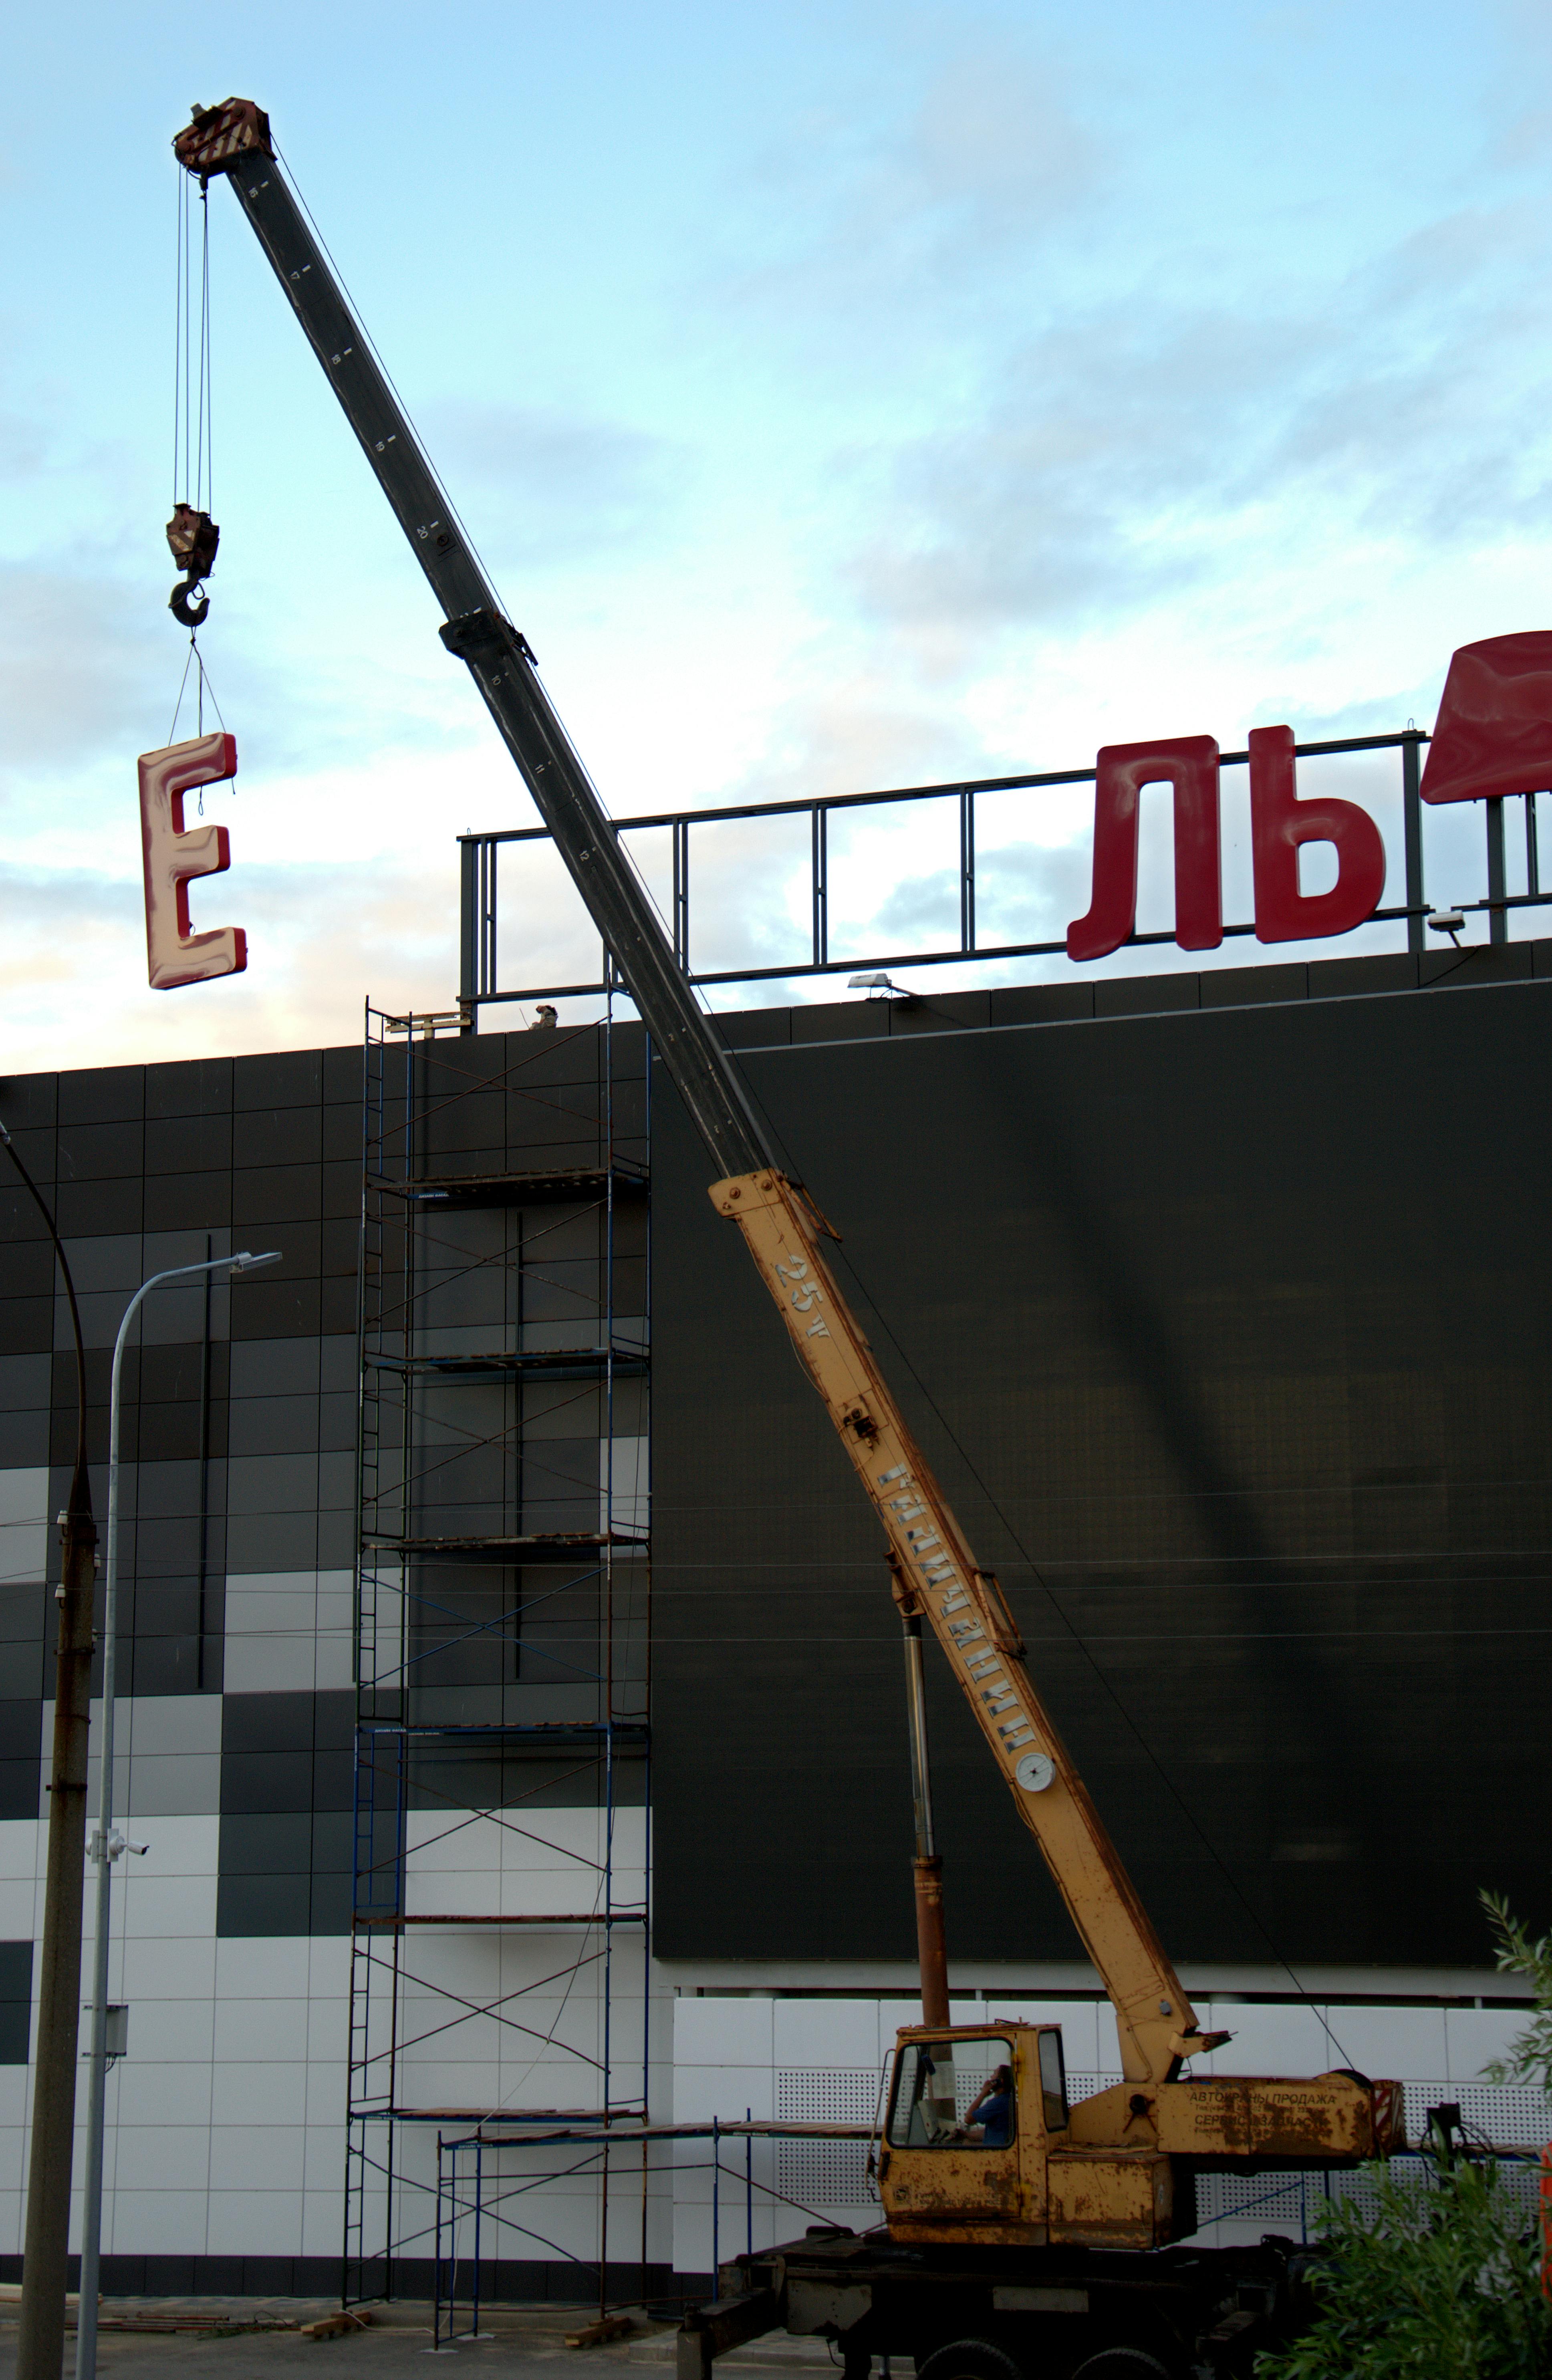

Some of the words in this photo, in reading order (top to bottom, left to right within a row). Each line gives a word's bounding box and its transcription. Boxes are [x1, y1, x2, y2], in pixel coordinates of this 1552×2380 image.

[290, 270, 300, 280] 17
[331, 354, 342, 365] 18
[375, 440, 385, 452] 19
[416, 525, 429, 539] 20
[491, 674, 501, 686] 10
[535, 763, 545, 774] 11
[579, 849, 590, 861] 12
[877, 1462, 1037, 1755] ГАЛИЧАНИН
[1272, 2093, 1336, 2106] ПРОДАЖА
